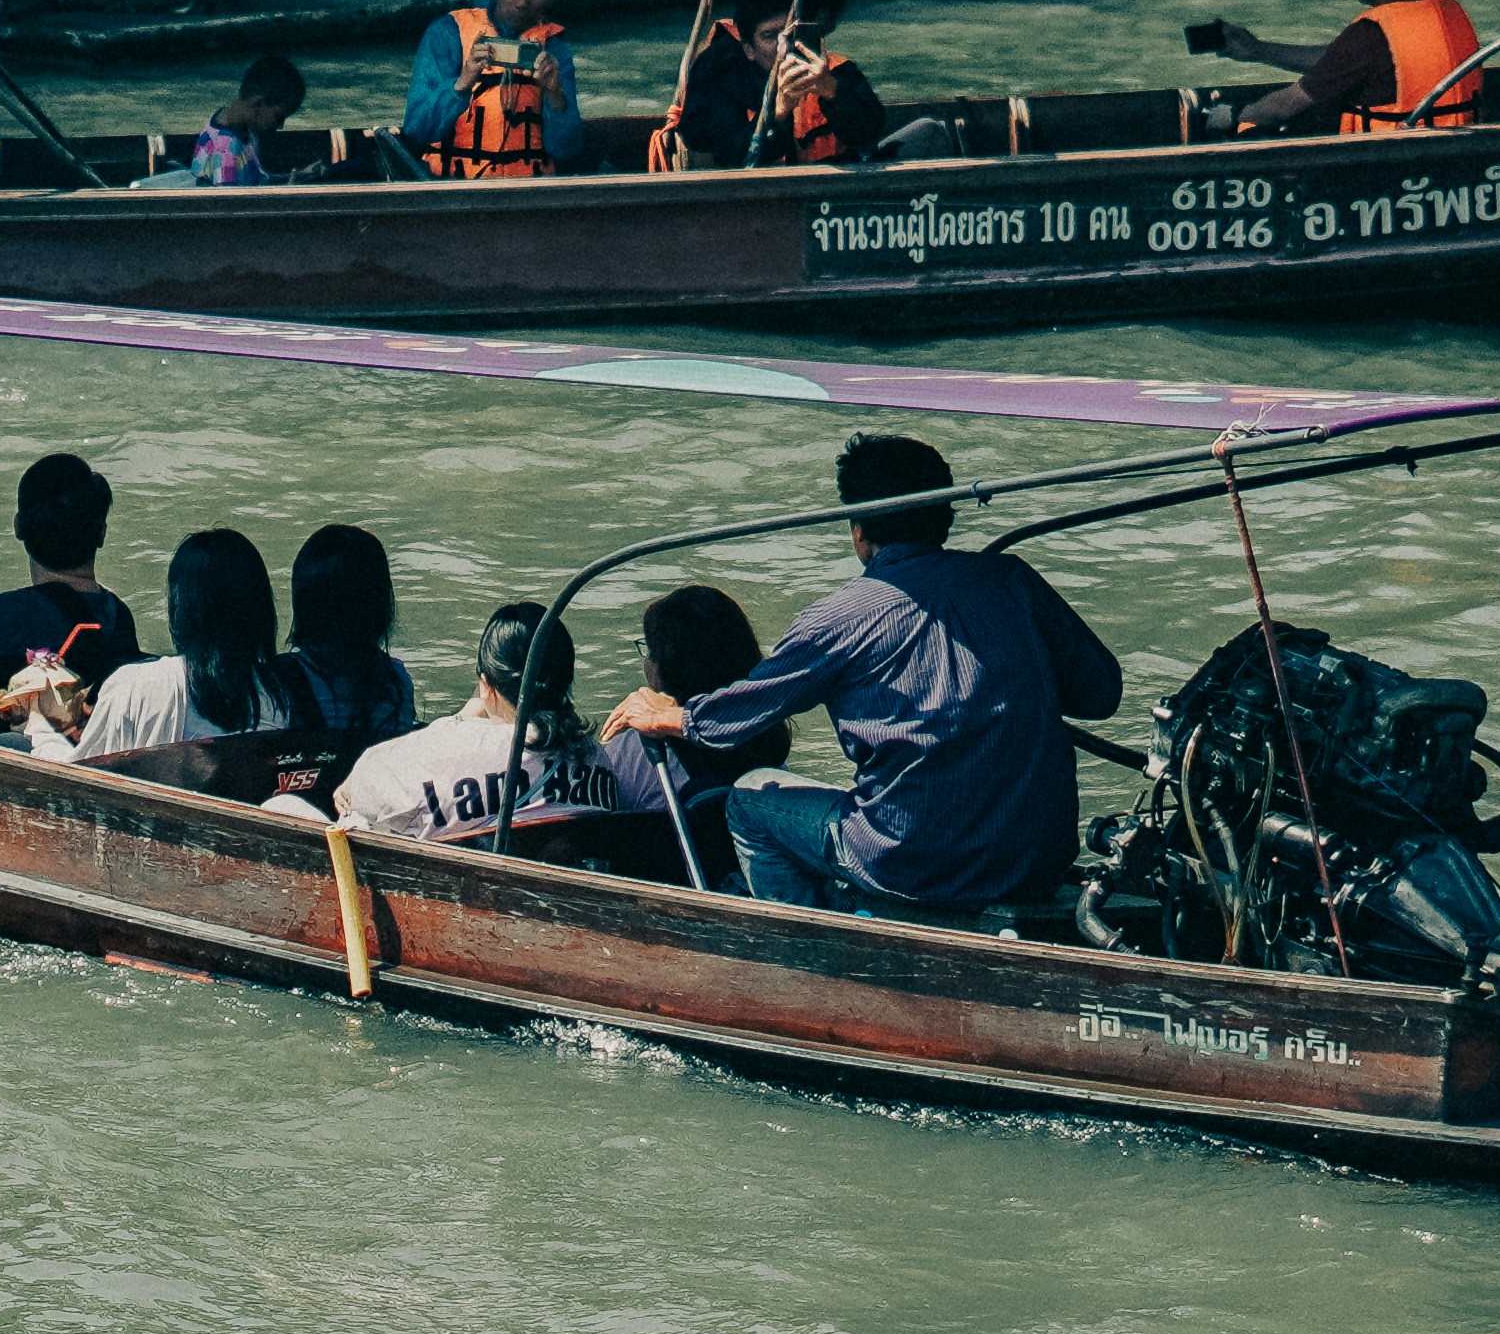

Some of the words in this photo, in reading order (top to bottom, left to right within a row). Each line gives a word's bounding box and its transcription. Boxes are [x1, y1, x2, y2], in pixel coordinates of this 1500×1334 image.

[1172, 178, 1273, 211] 6130
[811, 193, 1025, 263] จำนวนผู้โดยสาร
[1039, 200, 1076, 244] 10
[1088, 203, 1131, 242] คน
[1146, 216, 1274, 252] 00146
